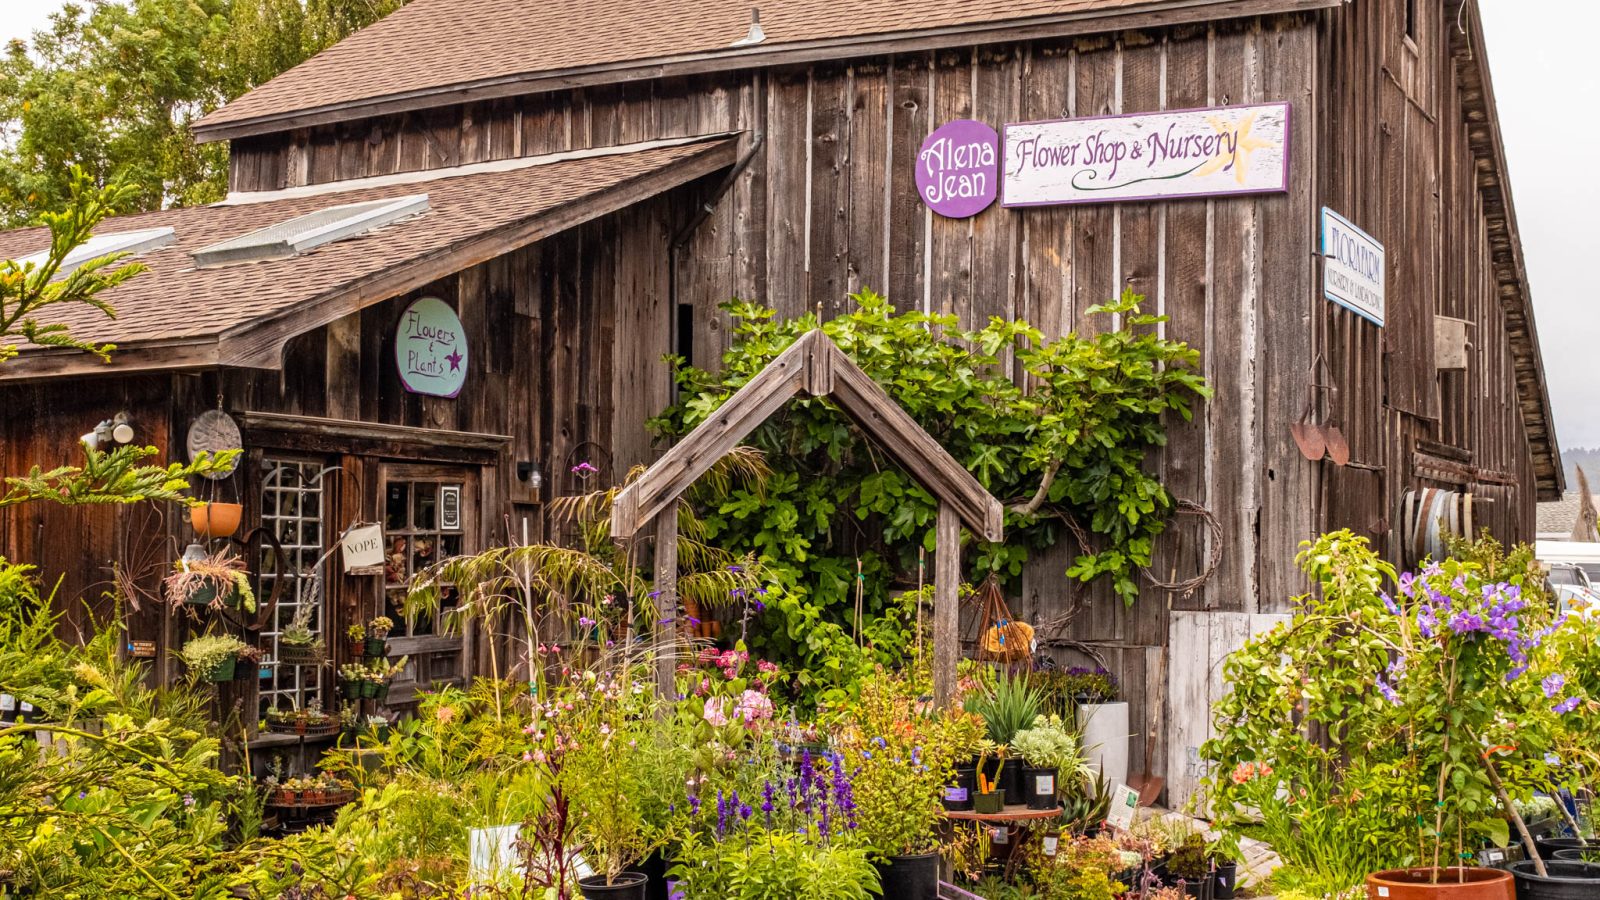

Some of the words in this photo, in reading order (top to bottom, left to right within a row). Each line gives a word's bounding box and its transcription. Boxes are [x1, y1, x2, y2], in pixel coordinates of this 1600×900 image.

[921, 137, 995, 178] Alena
[1016, 133, 1081, 174] Flower
[1083, 130, 1127, 180] Shop
[1130, 140, 1143, 160] &
[1147, 122, 1238, 172] Nursery
[925, 172, 986, 204] Jean
[406, 310, 456, 341] Flowers
[408, 349, 444, 374] Plants
[346, 538, 379, 555] NOPE
